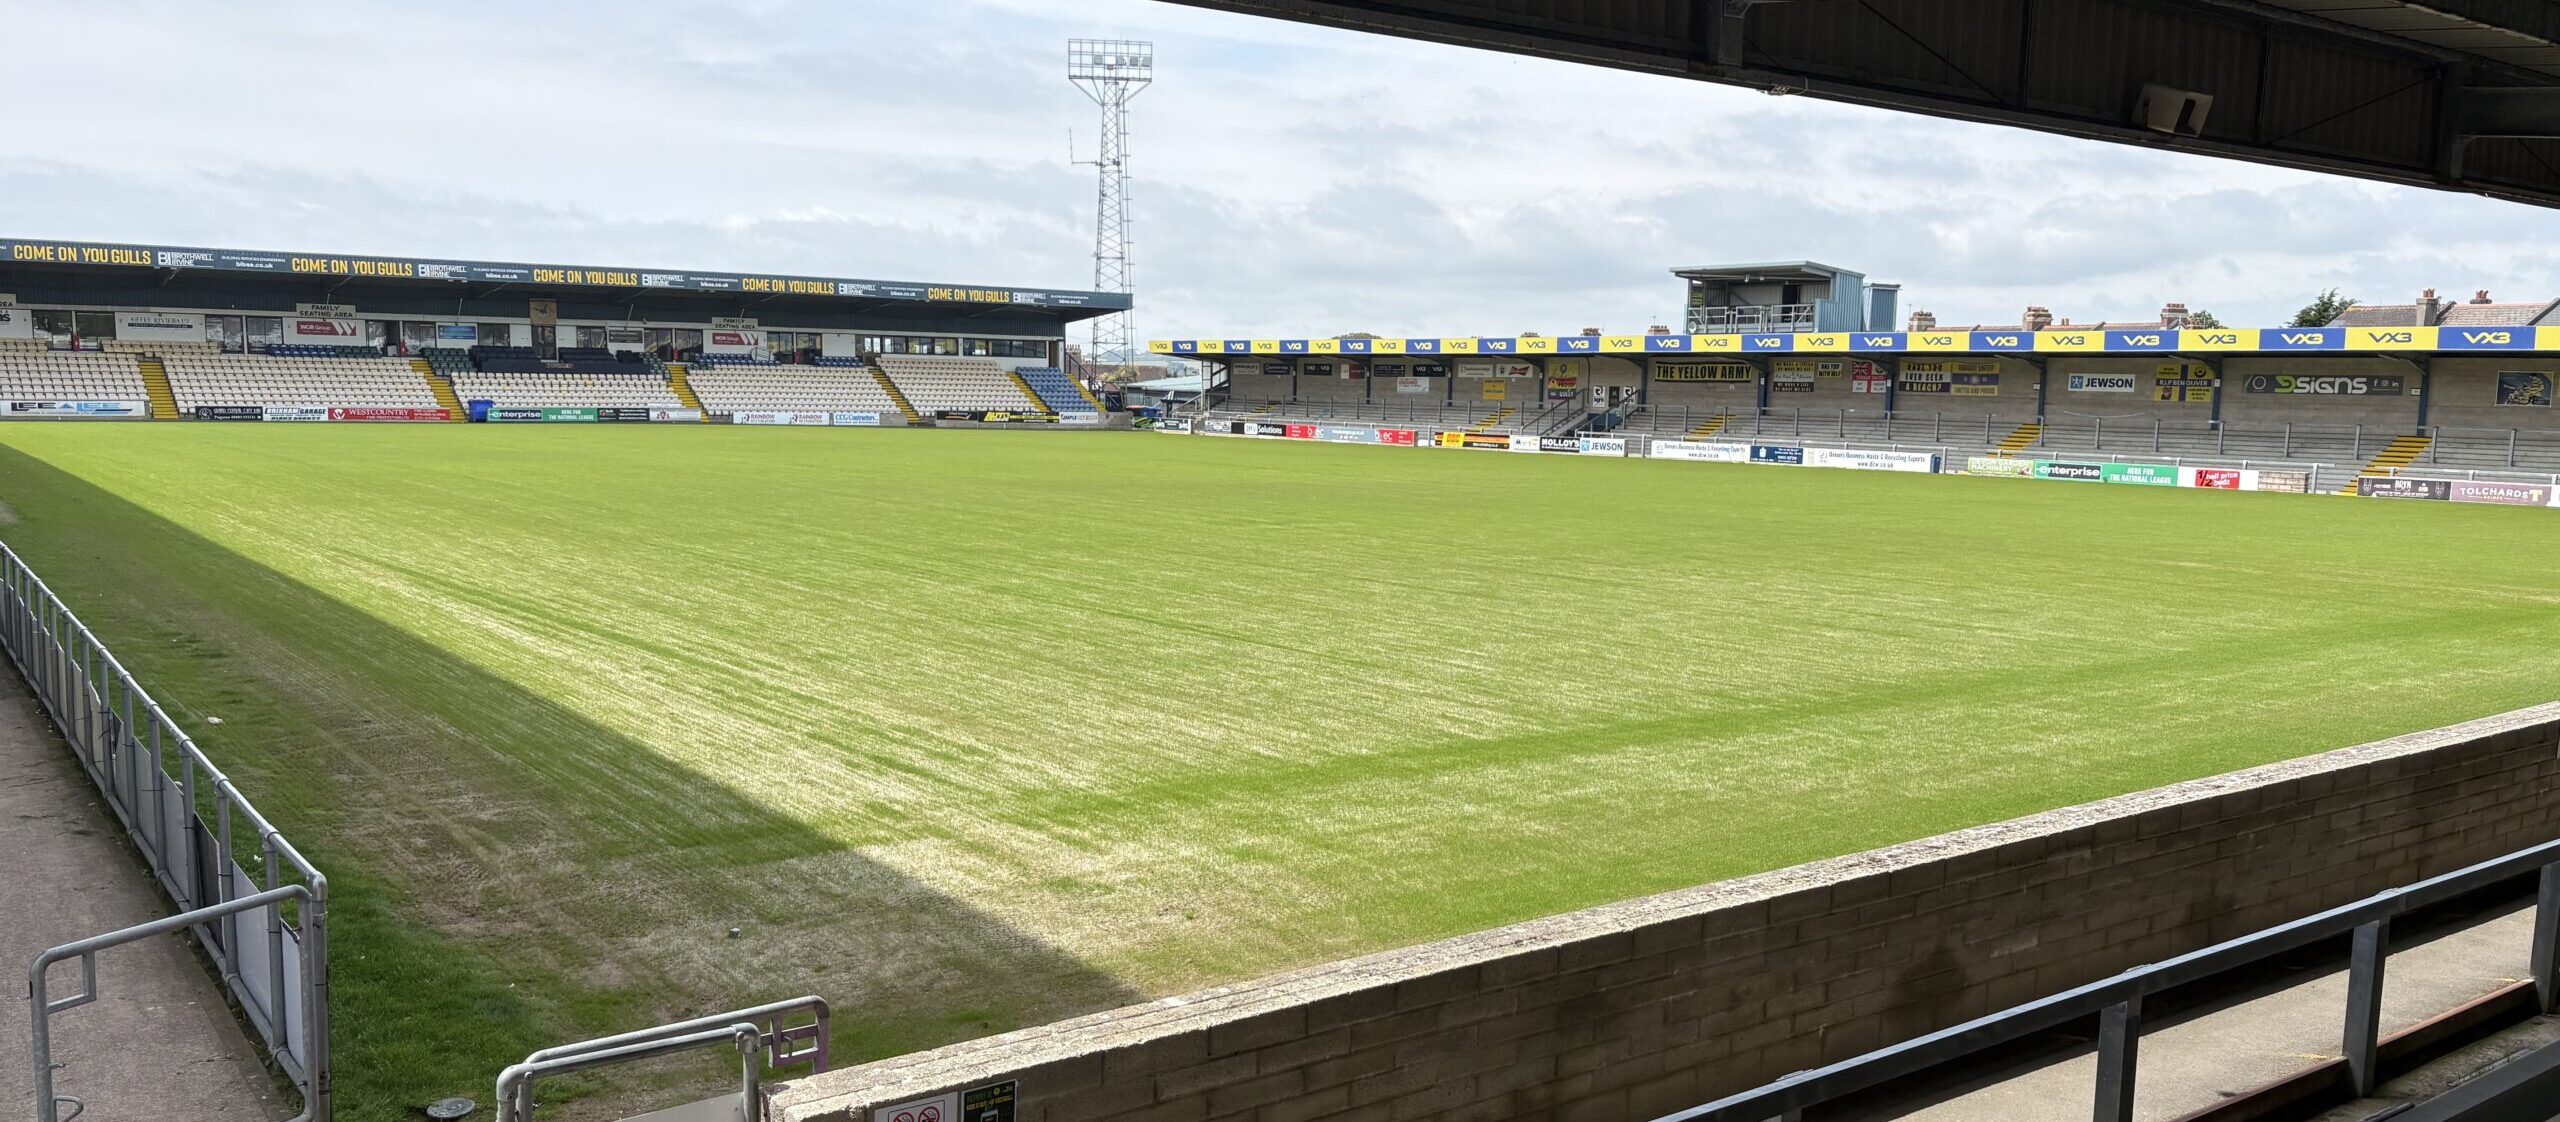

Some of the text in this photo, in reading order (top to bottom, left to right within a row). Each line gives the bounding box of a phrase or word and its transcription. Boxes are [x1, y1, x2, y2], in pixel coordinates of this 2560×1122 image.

[14, 245, 151, 265] COME ON YOU GULLS
[292, 258, 412, 276] COME ON YOU GULLS
[533, 269, 638, 286] COME ON YOU GULLS
[742, 278, 834, 295] COME ON YOU GULLS
[928, 287, 952, 300] COME
[954, 288, 966, 301] ON
[969, 291, 986, 302] YOU
[986, 291, 1009, 303] GULLS
[1807, 338, 1834, 346] VX3
[1864, 337, 1892, 347] VX3
[1922, 337, 1952, 345] VX3
[1985, 336, 2017, 346] VX3
[2052, 336, 2084, 345] VX3
[2123, 335, 2160, 346] VX3
[2198, 334, 2237, 344] VX3
[2281, 333, 2324, 344] VX3
[2368, 332, 2412, 343] VX3
[2462, 332, 2511, 344] VX3
[1178, 342, 1192, 350] VX3
[1230, 342, 1244, 350] VX3
[1257, 342, 1272, 350] VX3
[1286, 342, 1302, 350] VX3
[1347, 342, 1364, 350] VX3
[1414, 342, 1432, 350] VX3
[1487, 341, 1507, 350] VX3
[1568, 340, 1589, 349] VX3
[1656, 339, 1680, 348] VX3
[1704, 339, 1727, 347] VX3
[1754, 338, 1781, 348] VX3
[1656, 365, 1752, 379] THE YELLOW ARMY
[2085, 378, 2133, 388] JEWSON
[490, 411, 541, 419] enterprise
[1257, 424, 1282, 435] Solutions
[1591, 442, 1623, 451] JEWSON
[1884, 454, 1907, 463] Recycling
[2039, 465, 2100, 476] enterprise
[2127, 467, 2154, 476] HERE FOR
[2109, 473, 2171, 484] THE NATIONAL LEAGUE
[2459, 487, 2528, 499] TOLCHARDS
